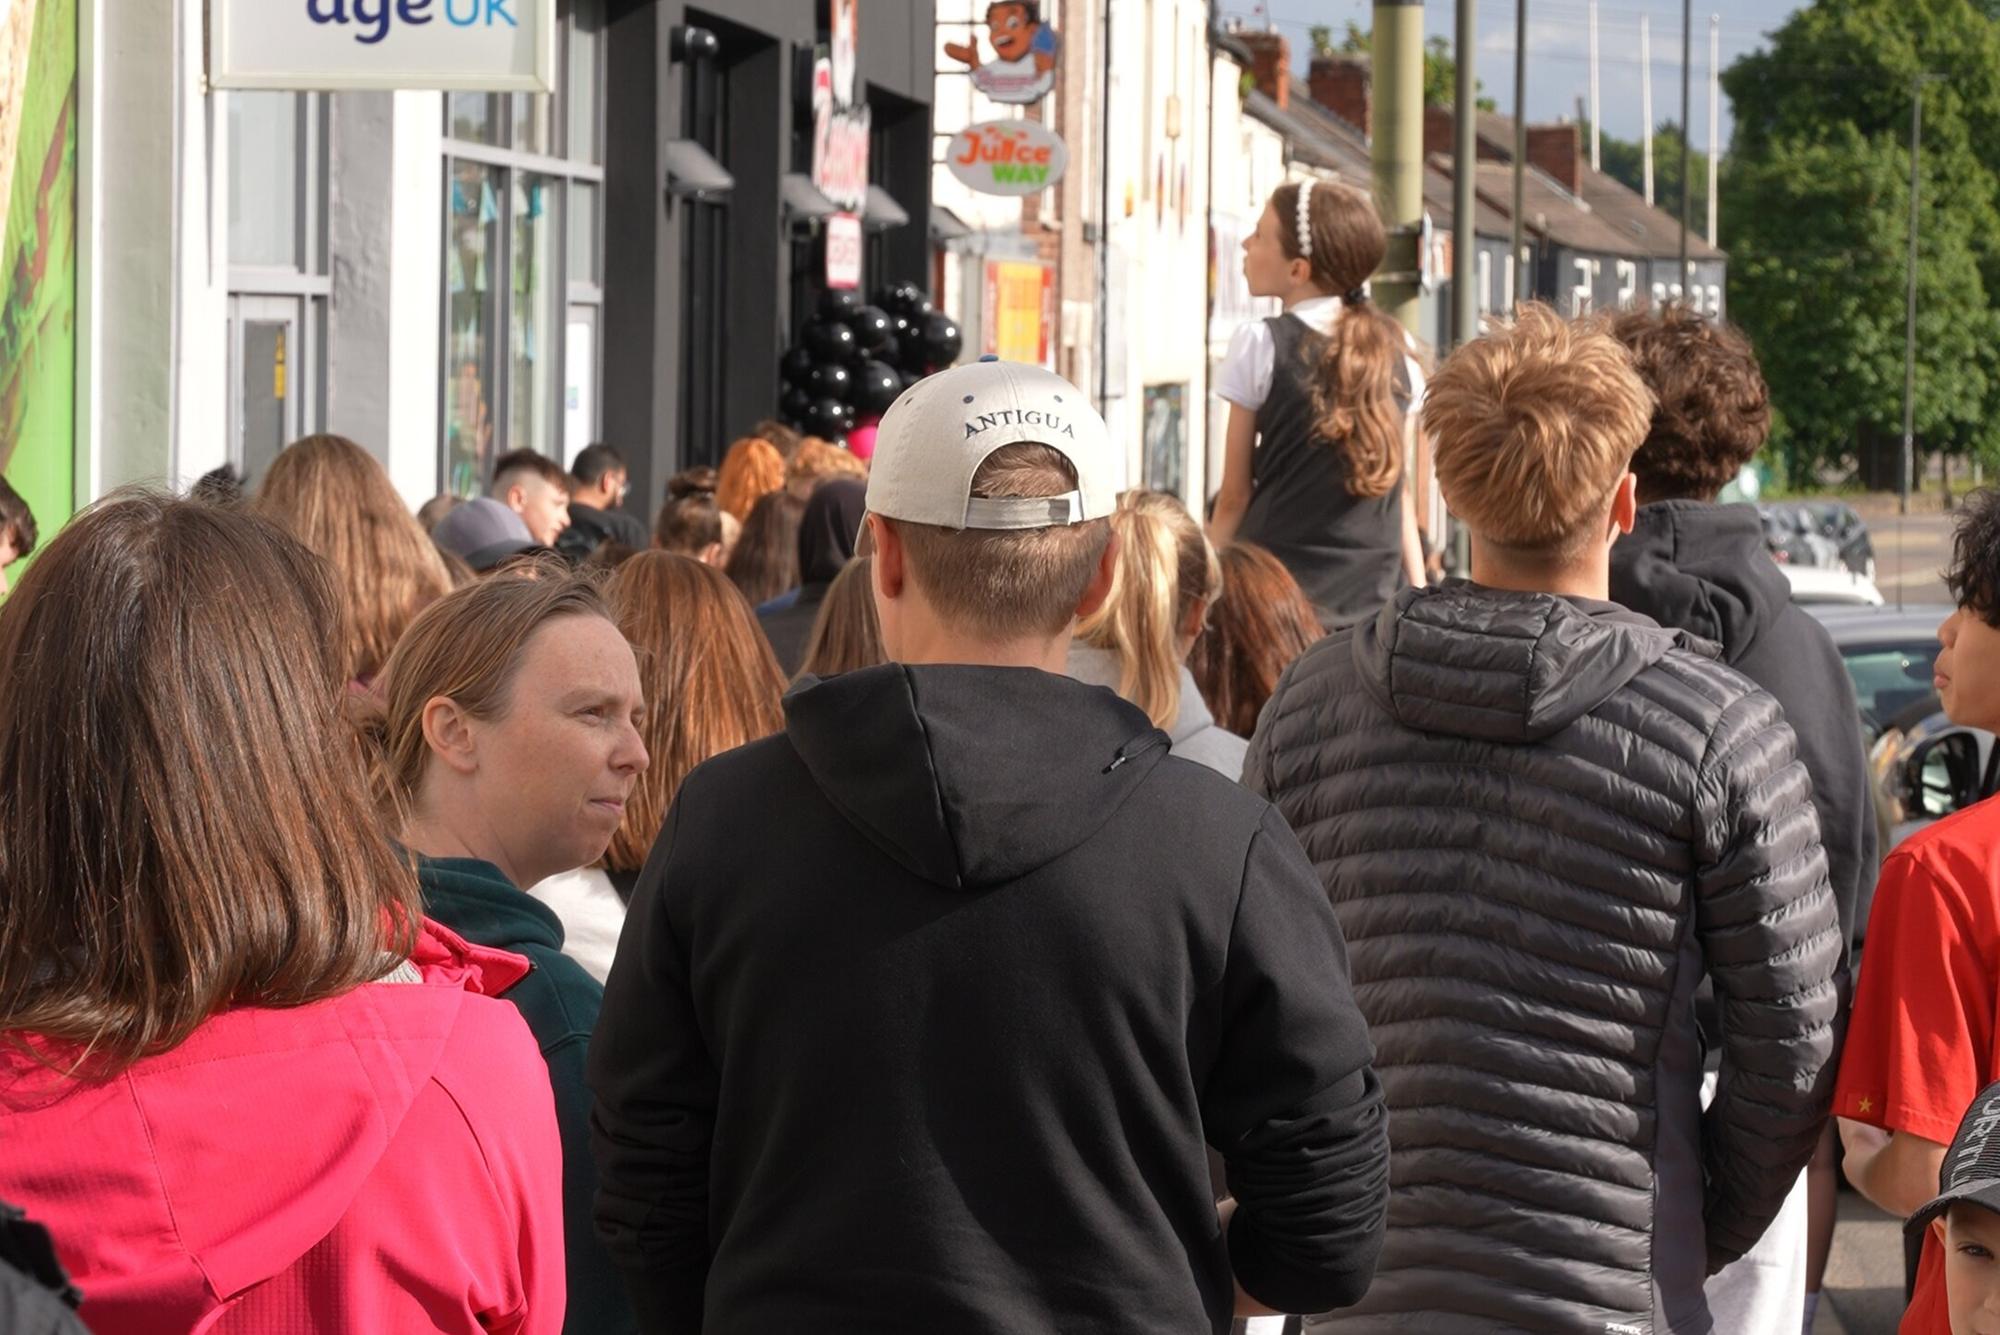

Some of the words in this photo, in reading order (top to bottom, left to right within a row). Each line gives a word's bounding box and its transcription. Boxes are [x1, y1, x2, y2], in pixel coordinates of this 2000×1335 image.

[306, 0, 433, 44] age
[445, 0, 518, 27] UK
[991, 164, 1050, 185] WAY
[965, 410, 1075, 440] ANTIGUA
